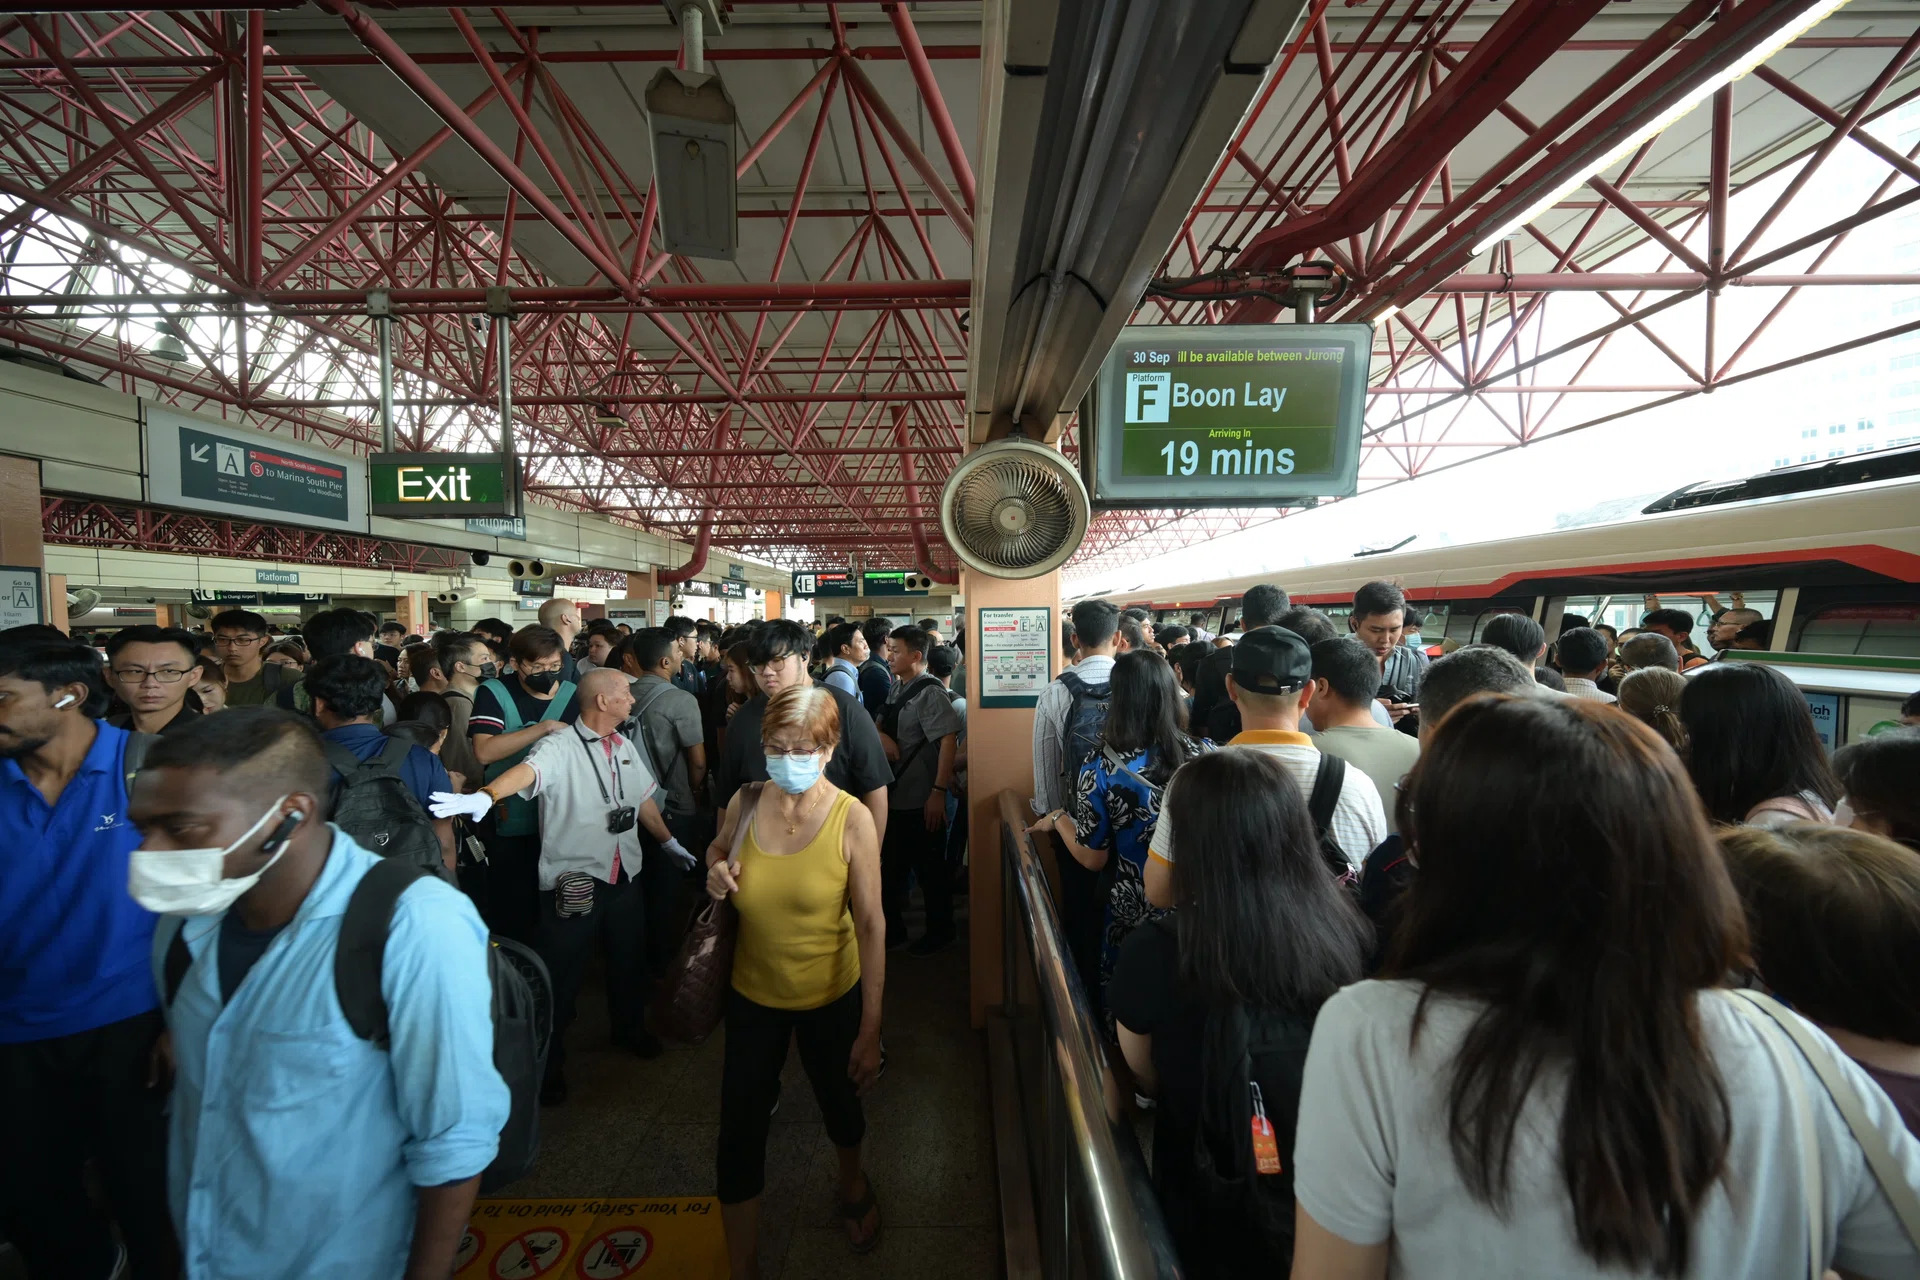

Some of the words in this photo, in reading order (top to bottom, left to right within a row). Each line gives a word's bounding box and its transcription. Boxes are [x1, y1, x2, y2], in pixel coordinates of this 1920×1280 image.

[1133, 351, 1147, 364] 30
[1149, 351, 1171, 366] Sep
[1189, 350, 1204, 363] be
[1206, 349, 1255, 363] available
[1257, 349, 1302, 362] between
[1305, 349, 1344, 364] Jurong
[1132, 373, 1165, 383] Platform
[1137, 384, 1159, 421] F
[1172, 382, 1236, 408] Boon
[1244, 381, 1288, 412] Lay
[1208, 429, 1242, 440] Arriving
[224, 452, 239, 475] A
[281, 459, 295, 467] North
[294, 461, 308, 470] South
[1160, 440, 1199, 477] 19
[1210, 439, 1296, 475] mins
[265, 468, 275, 477] to
[276, 469, 305, 484] Marina
[306, 476, 328, 488] South
[329, 481, 343, 491] Pier
[397, 466, 472, 502] Exit
[316, 488, 343, 499] Woodlands
[258, 571, 290, 582] Platform
[804, 578, 812, 591] E
[16, 591, 30, 607] A
[1022, 621, 1028, 631] E
[1037, 621, 1045, 631] A
[484, 1204, 505, 1218] To
[507, 1204, 533, 1218] On
[536, 1203, 577, 1217] Hold
[582, 1201, 640, 1217] Safety,
[640, 1202, 679, 1217] Your
[683, 1202, 712, 1217] For
